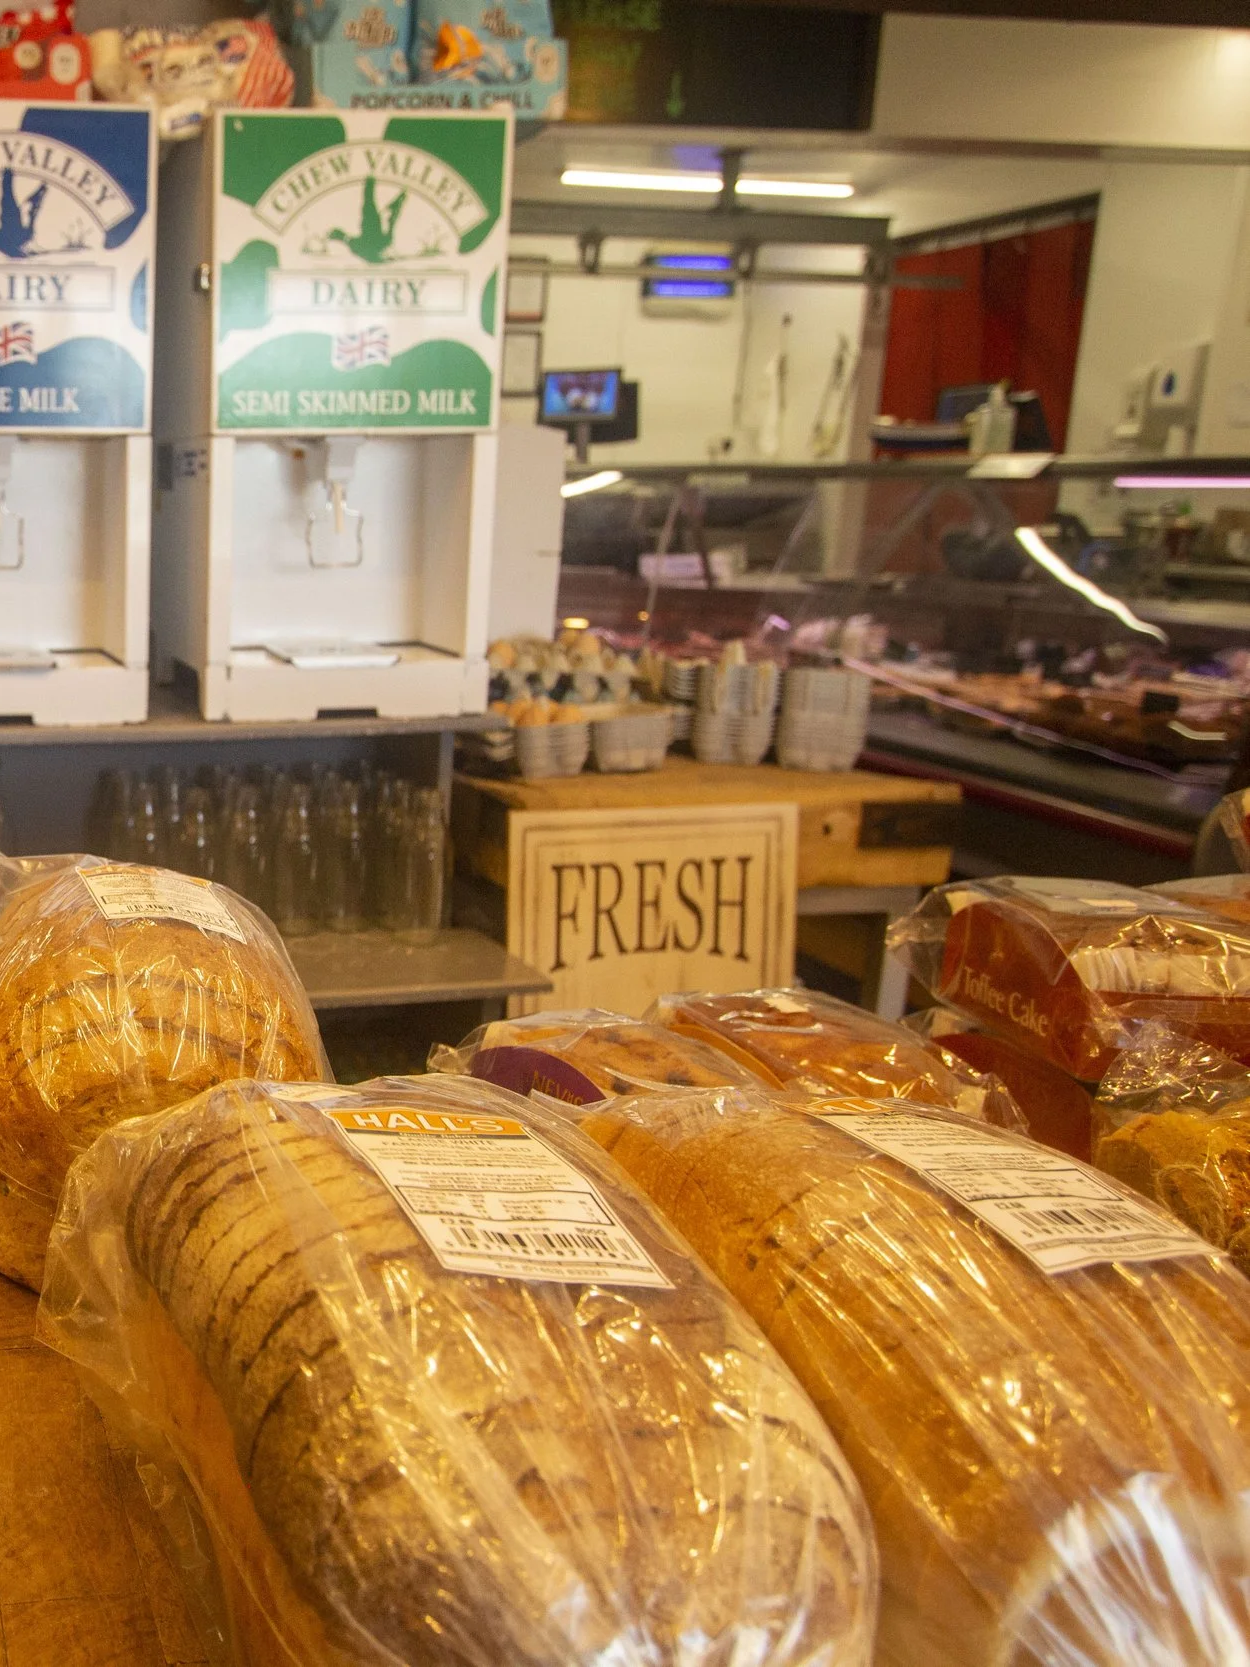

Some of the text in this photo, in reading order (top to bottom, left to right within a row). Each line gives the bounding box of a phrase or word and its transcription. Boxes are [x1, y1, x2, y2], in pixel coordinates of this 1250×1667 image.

[350, 92, 454, 109] POPCORN
[458, 92, 473, 109] &
[0, 140, 120, 204] VALLEY
[270, 149, 477, 214] CHEW VALLEY
[311, 278, 427, 307] DAIRY
[18, 387, 79, 414] MILK
[232, 389, 477, 416] SEMI SKIMMED MILK
[550, 855, 753, 973] FRESH
[962, 965, 1049, 1037] Toffee Cake
[353, 1112, 504, 1132] HALL'S
